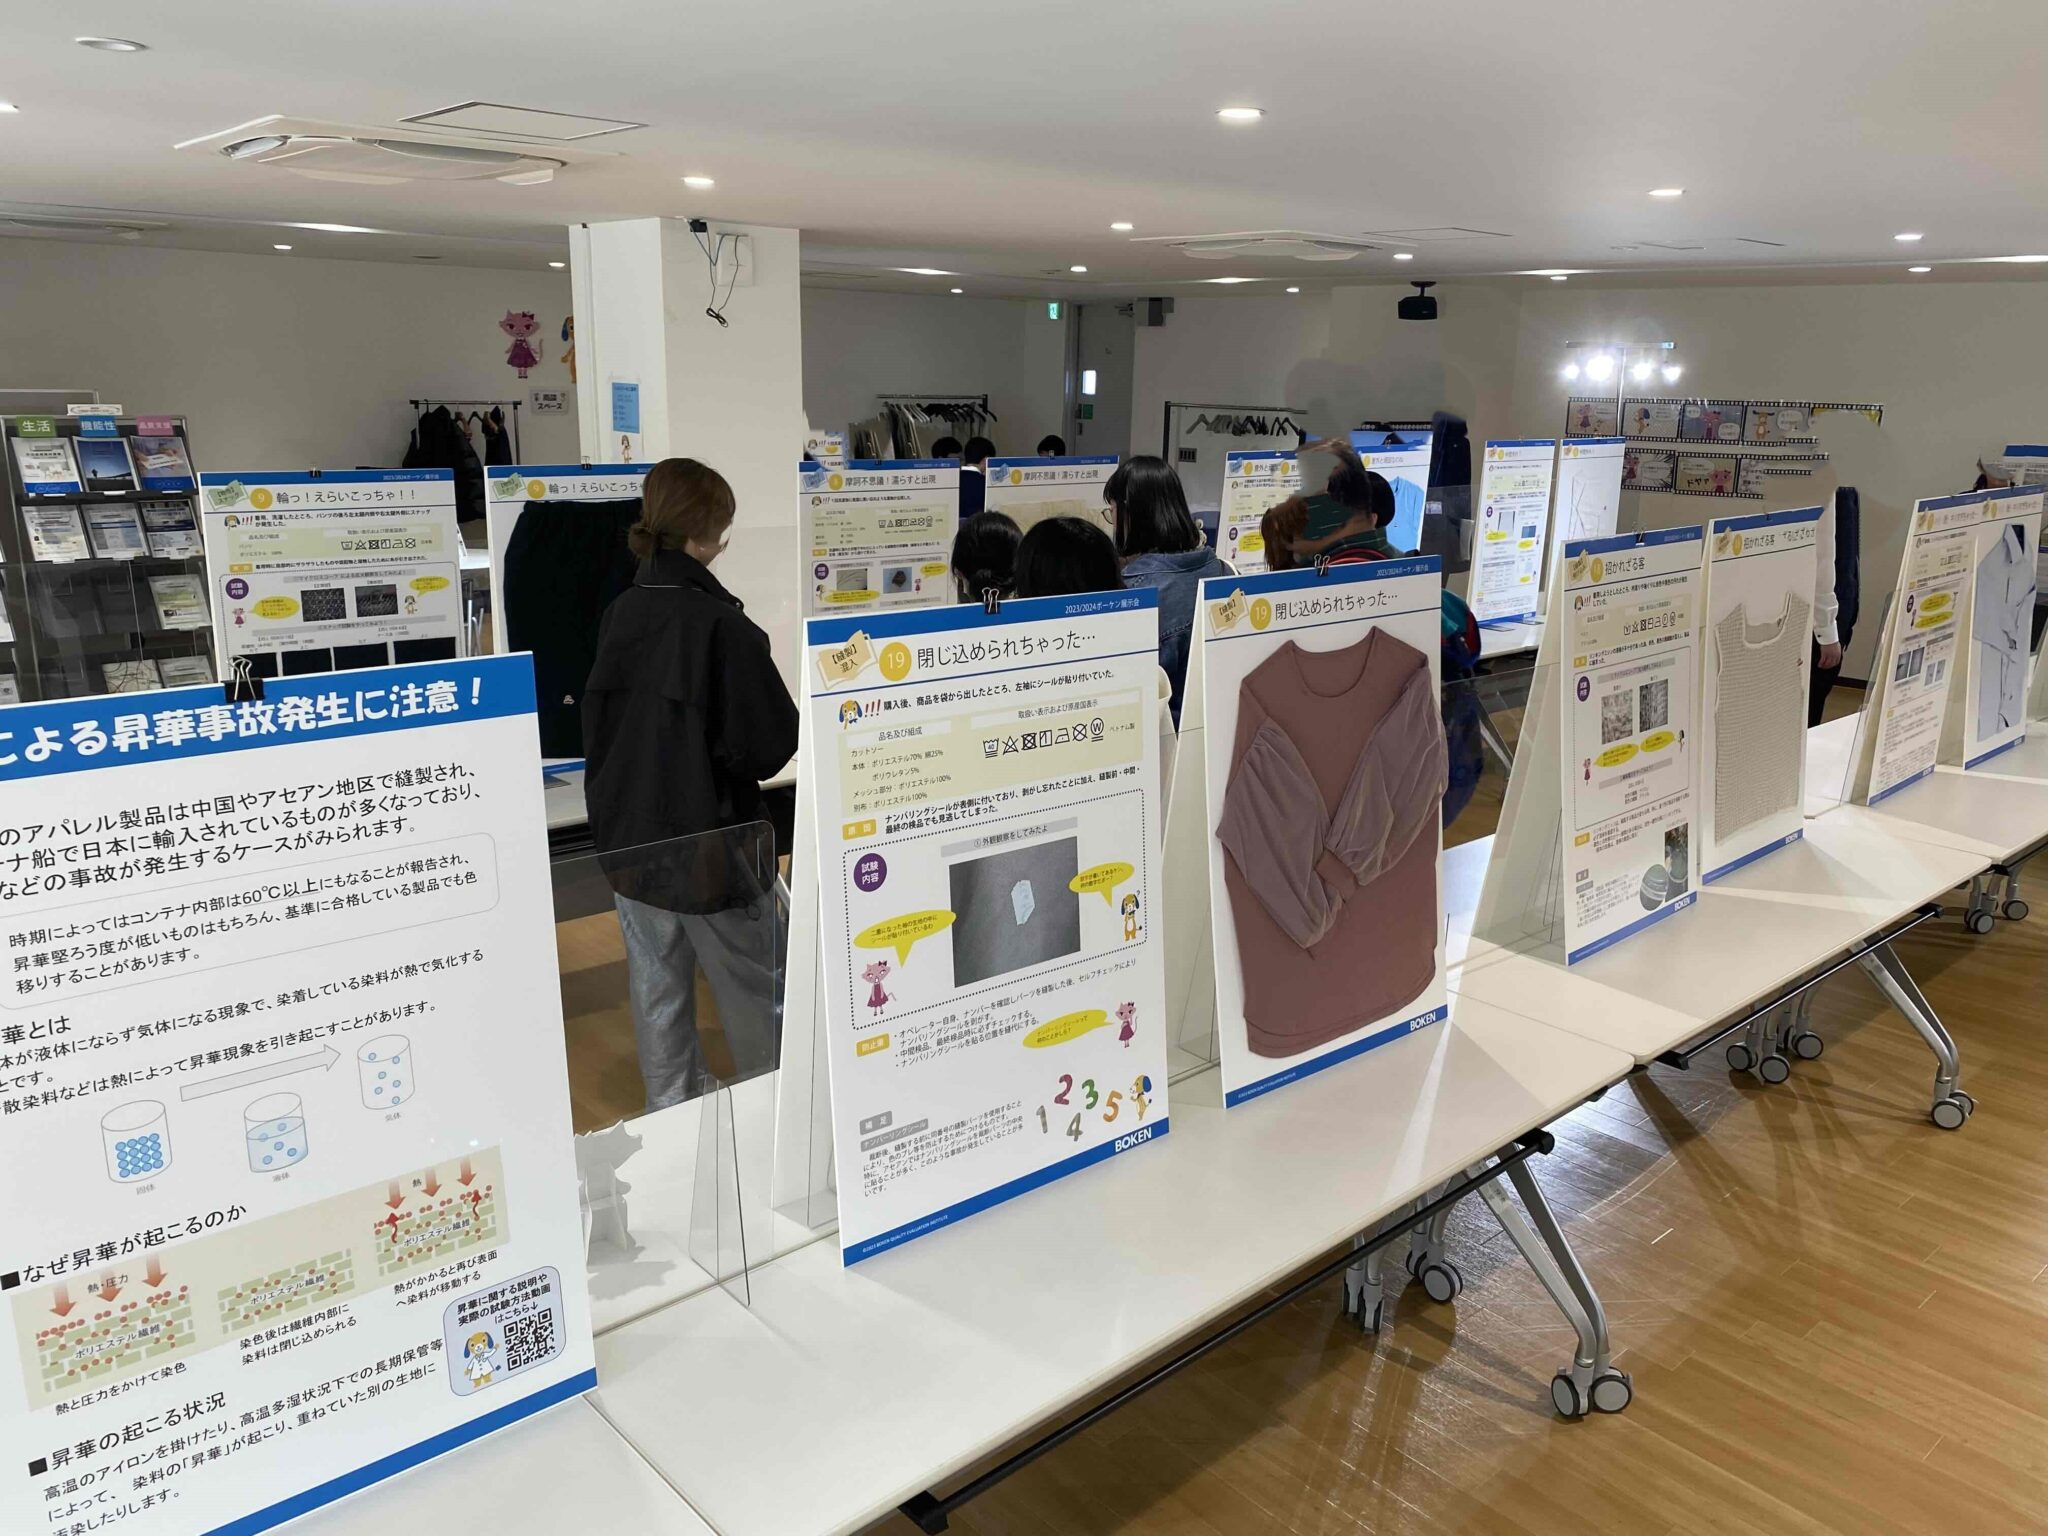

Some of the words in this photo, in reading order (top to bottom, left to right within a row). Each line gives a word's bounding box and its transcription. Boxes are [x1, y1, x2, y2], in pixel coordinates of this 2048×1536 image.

[22, 420, 50, 432] 生活
[81, 420, 116, 431] 機能性
[549, 481, 643, 494] 輪っ！えらいこっち
[1255, 606, 1267, 620] 19
[887, 651, 905, 669] 19
[878, 726, 923, 741] 品名及び組成
[851, 747, 884, 758] カットソー
[0, 762, 475, 846] のアパレル製品は中国やアセアン地区で縫製され、
[0, 783, 481, 873] ナ船で日本に輸入されているものが多くなっており、
[0, 816, 415, 900] などの事故が発生するケースがみられます。
[861, 860, 879, 873] 試験
[862, 872, 879, 885] 内容
[13, 871, 478, 972] 昇華堅ろう度が低いものはもちろん、基準に合格している製品でも色
[16, 947, 200, 995] 移りすることがあります。
[1409, 1011, 1437, 1032] BOKEN
[0, 1000, 436, 1115] 散染料などは熱によって昇華現象を引き起こすことがあります。
[1054, 1074, 1073, 1105] 2
[1081, 1079, 1099, 1110] 3
[1036, 1105, 1048, 1134] 1
[1103, 1090, 1123, 1122] 5
[1066, 1112, 1084, 1142] 4
[1115, 1127, 1152, 1153] BOKEN
[412, 1178, 422, 1188] 熱
[403, 1218, 471, 1248] ポリエステル繊維
[87, 1274, 129, 1294] 熱・圧力
[394, 1250, 498, 1295] 熱がかかると再び表面
[250, 1274, 326, 1306] ポリエステル繊維
[395, 1271, 482, 1308] へ染料が移動する
[457, 1273, 548, 1315] 昇華に関する説明や
[458, 1283, 551, 1327] 実際の試験方法動画
[75, 1324, 161, 1359] ポリエステル繊維
[240, 1304, 350, 1351] 染色後は繊維内部に
[241, 1316, 357, 1366] 染料は閉じ込められる
[55, 1362, 187, 1416] 熱と圧力をかけて染色
[44, 1338, 444, 1501] 高温のアイロンを掛けたり、高温多湿状況下での長期保管等
